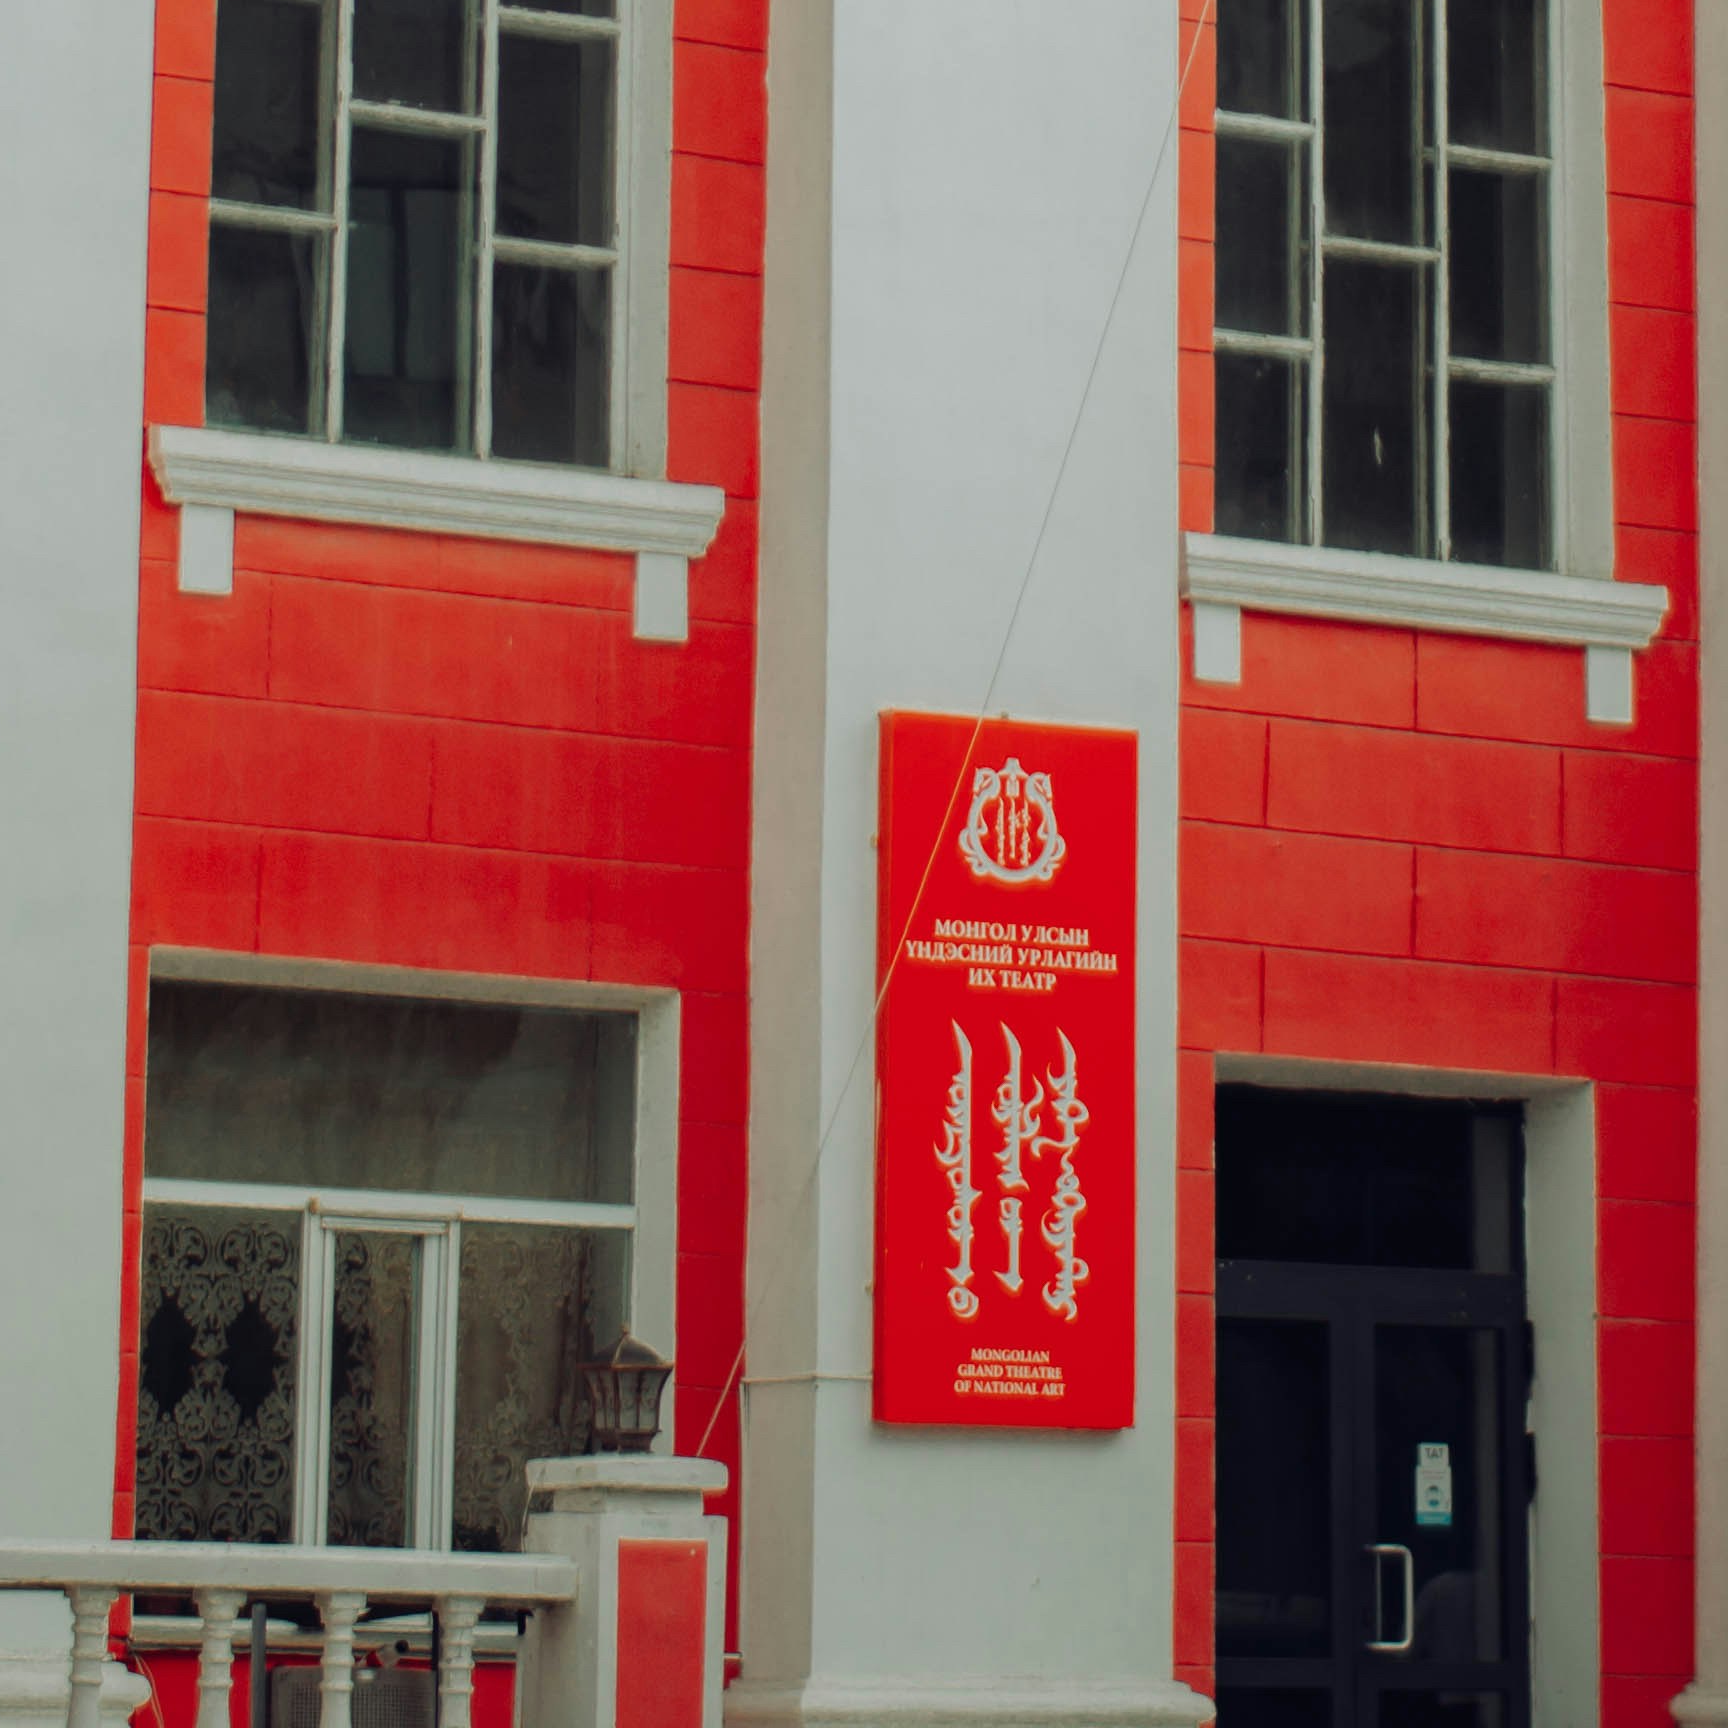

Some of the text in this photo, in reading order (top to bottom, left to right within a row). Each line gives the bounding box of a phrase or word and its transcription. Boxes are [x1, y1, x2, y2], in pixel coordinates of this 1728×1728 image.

[934, 919, 1089, 946] МОНГОЛ УЛСЫН
[906, 940, 1117, 971] ҮНДЭСНИЙ УРЛАГИЙН
[969, 968, 1056, 990] ИХ ТЕАТР
[971, 1348, 1050, 1363] MONGOLIAN
[958, 1364, 1063, 1379] GRAND THEATRE
[954, 1380, 1065, 1396] OF NATIONAL ART
